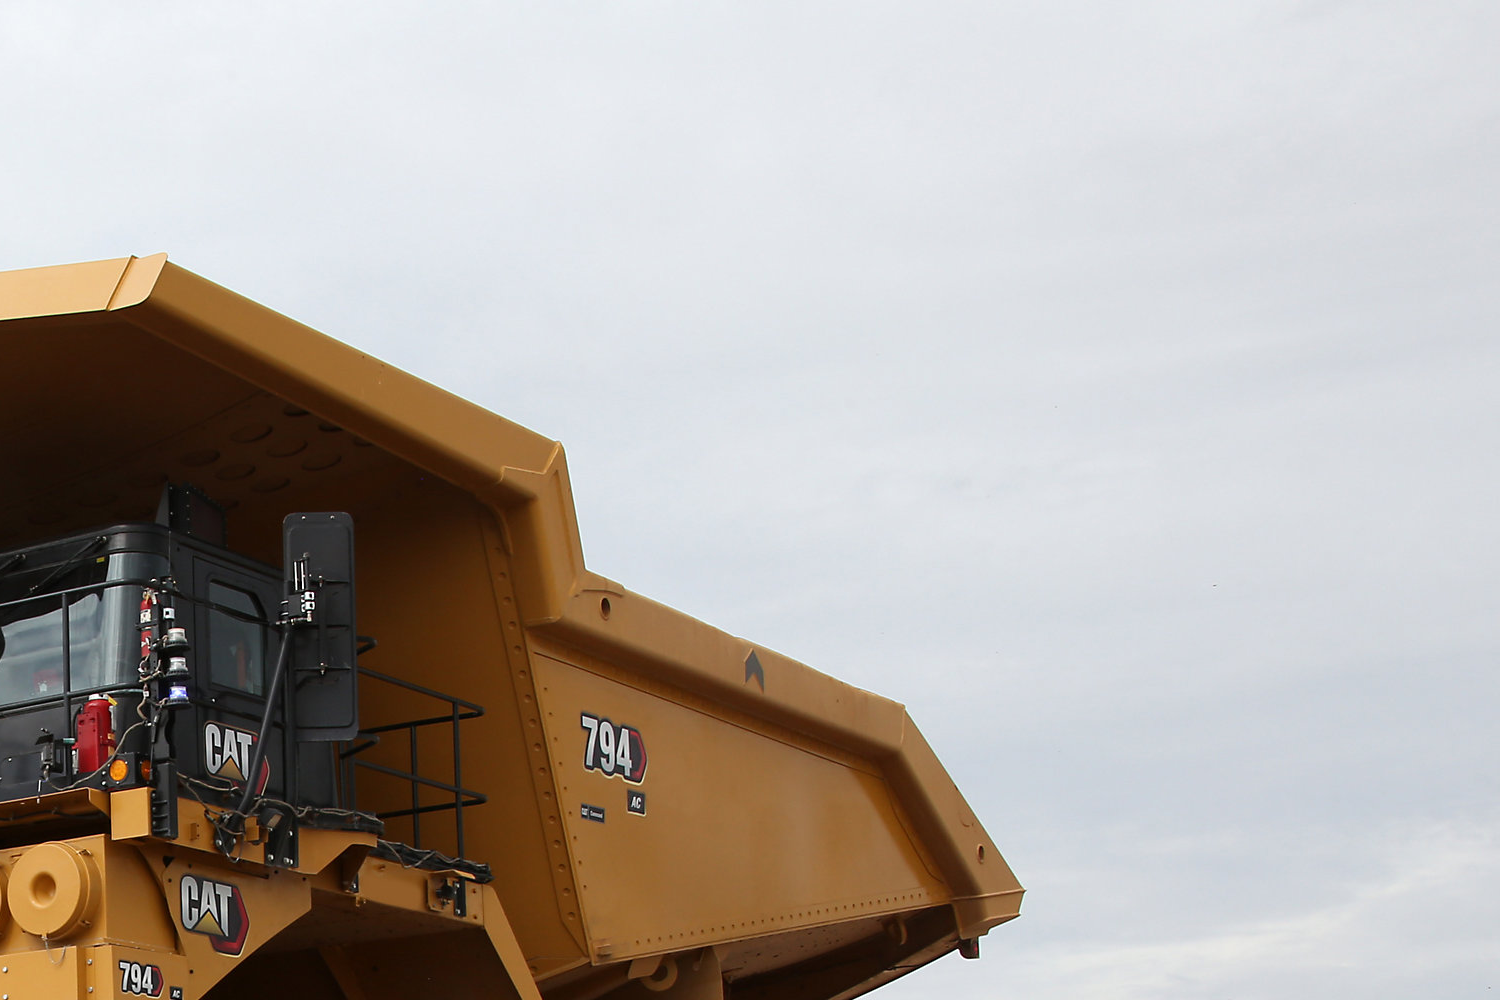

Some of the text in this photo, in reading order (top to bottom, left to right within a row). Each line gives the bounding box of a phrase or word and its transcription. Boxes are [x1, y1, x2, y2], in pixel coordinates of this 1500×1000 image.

[205, 723, 253, 781] CAT
[582, 715, 632, 777] 794
[630, 796, 642, 809] AC
[181, 876, 232, 937] CAT
[119, 961, 153, 995] 794
[172, 989, 181, 998] AC
